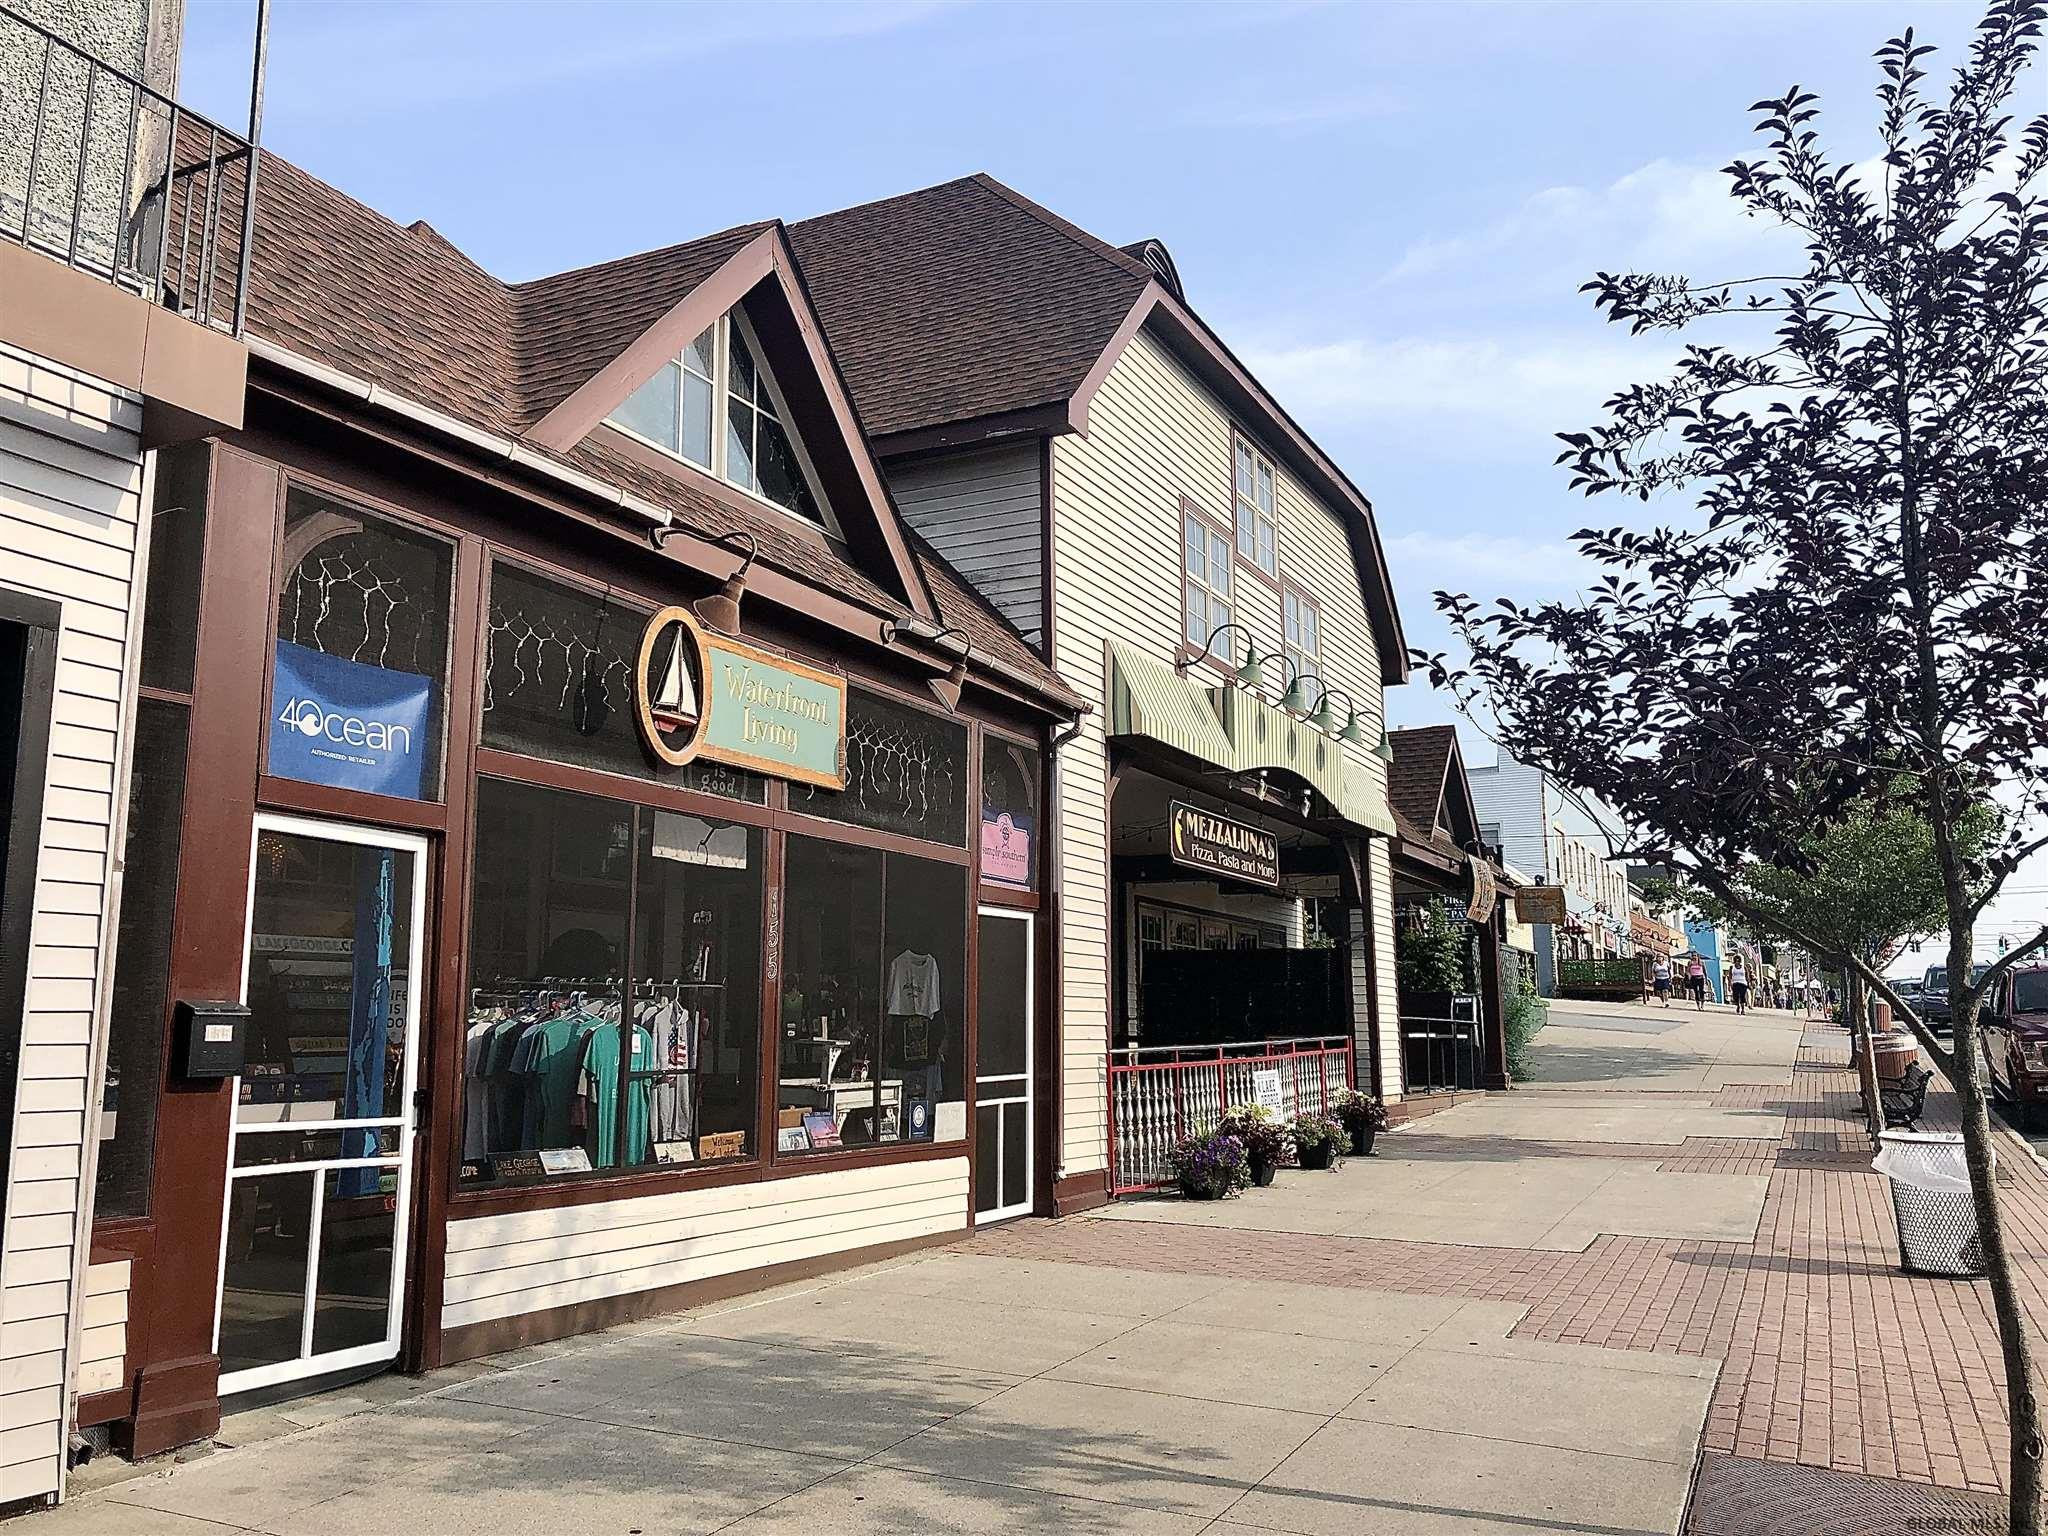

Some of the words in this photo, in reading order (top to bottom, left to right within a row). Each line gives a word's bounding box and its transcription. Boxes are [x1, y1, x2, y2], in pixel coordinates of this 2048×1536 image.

[723, 664, 831, 725] Waterfront
[742, 705, 797, 753] Living
[310, 748, 347, 761] AUTHORIZED
[348, 755, 377, 766] RETAILER
[1186, 812, 1276, 861] MEZZALUNA'S
[1002, 849, 1026, 863] southern
[1218, 852, 1240, 871] Pasta
[1241, 858, 1256, 874] and
[1257, 862, 1276, 880] More
